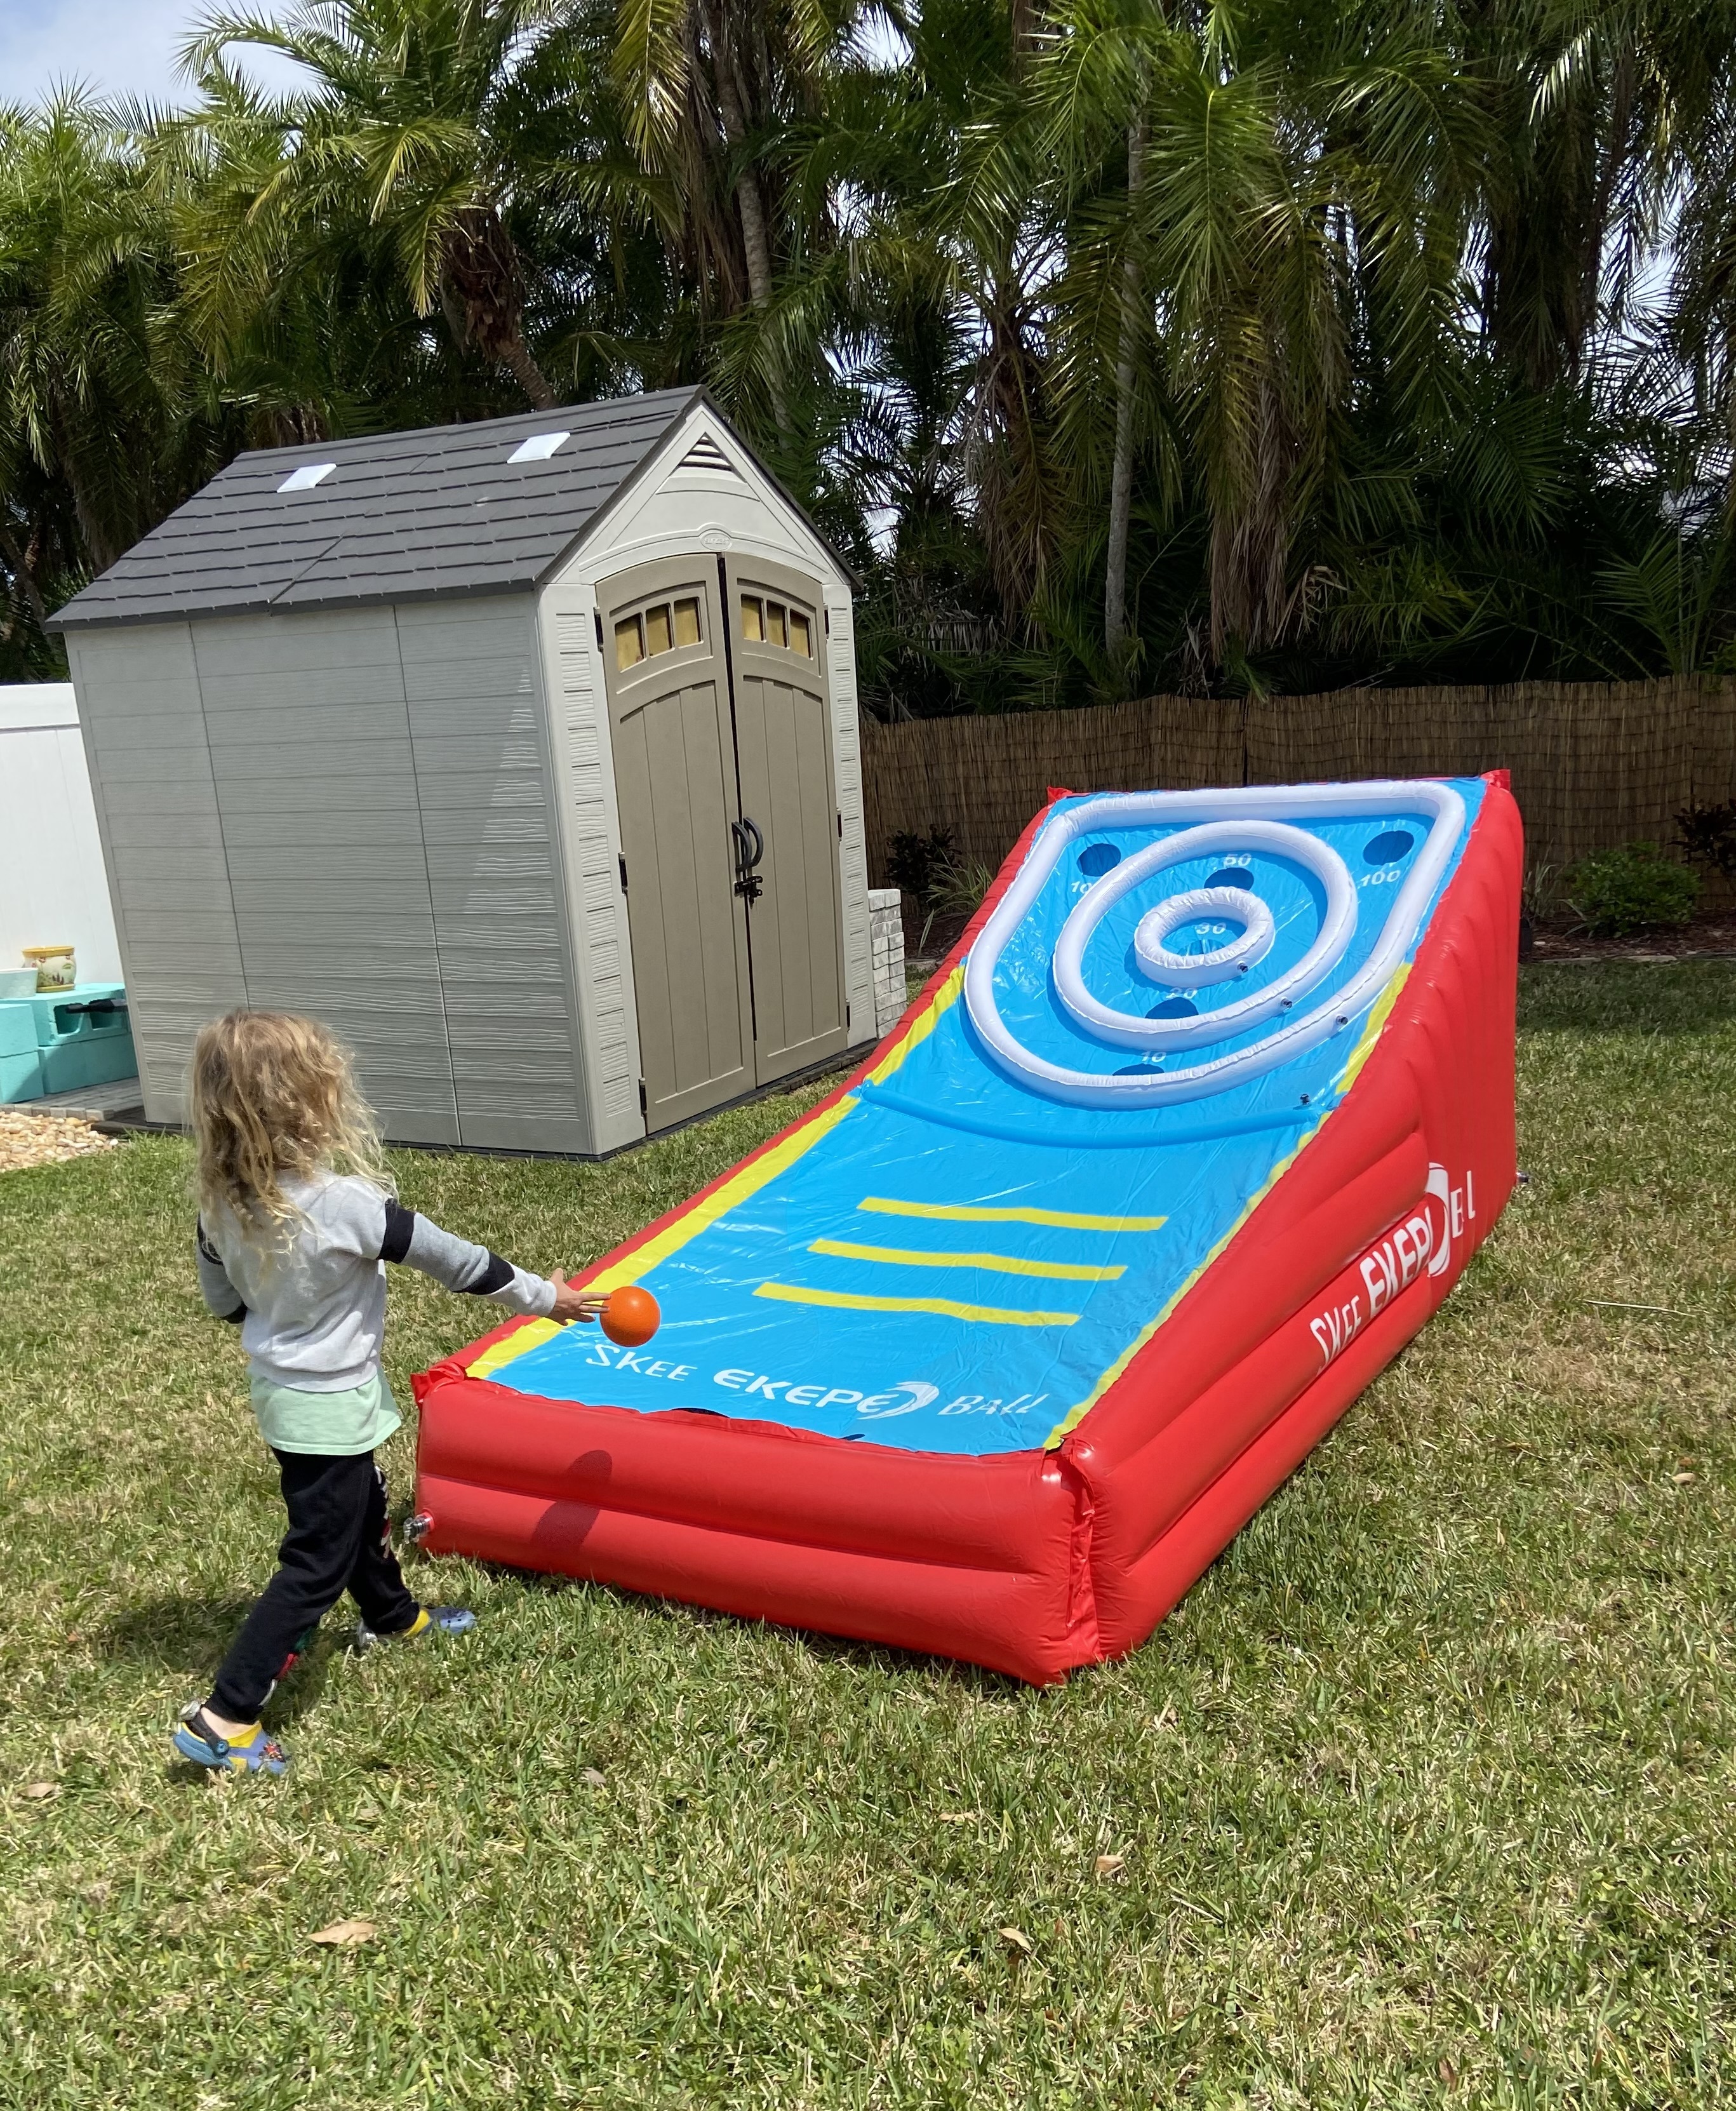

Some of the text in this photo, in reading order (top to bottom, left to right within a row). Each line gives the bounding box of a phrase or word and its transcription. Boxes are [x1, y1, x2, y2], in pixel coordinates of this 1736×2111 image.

[1223, 853, 1252, 868] 50
[1360, 869, 1401, 887] 100
[1196, 922, 1226, 935] 30
[1166, 987, 1198, 999] 20
[1141, 1051, 1166, 1062] 10
[585, 1344, 698, 1381] SKEE
